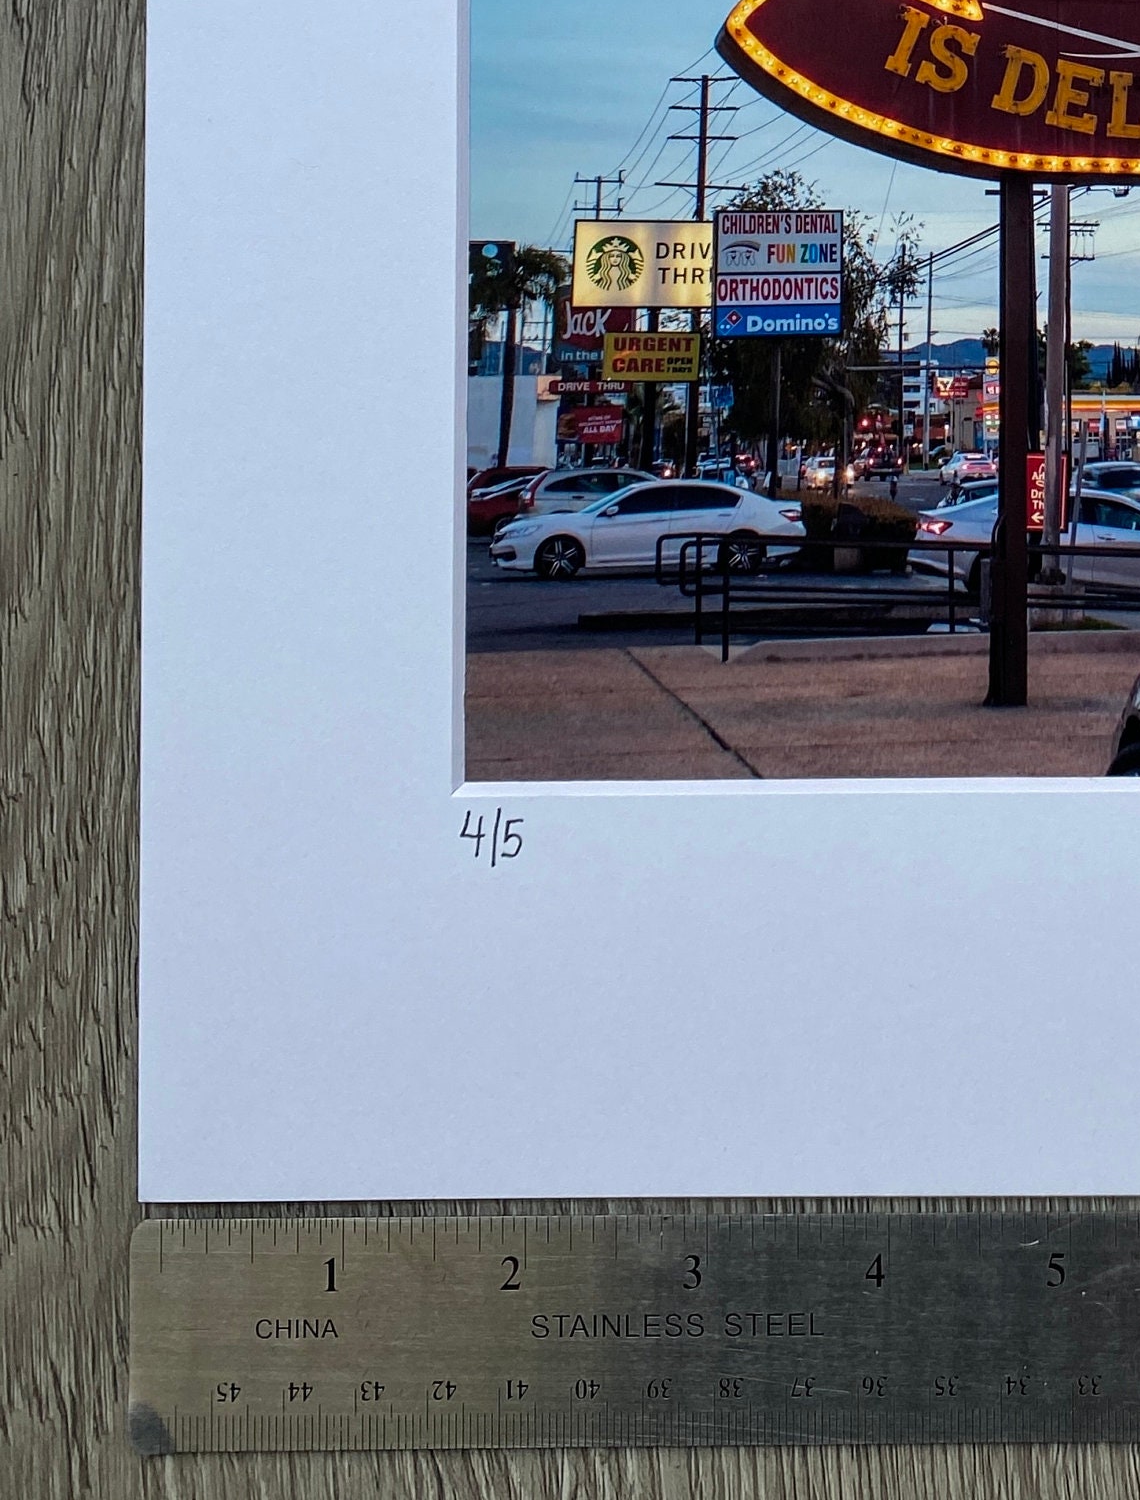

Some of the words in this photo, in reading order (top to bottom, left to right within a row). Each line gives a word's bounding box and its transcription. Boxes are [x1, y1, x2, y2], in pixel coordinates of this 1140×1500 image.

[884, 6, 981, 94] IS
[722, 214, 792, 235] CHILDREN'S
[795, 214, 838, 234] DENTAL
[656, 242, 712, 259] DRIV
[767, 243, 796, 264] FUN
[800, 243, 838, 263] ZONE
[658, 267, 714, 284] THR
[717, 276, 839, 302] ORTHODONTICS
[562, 300, 613, 340] Jack
[746, 313, 838, 333] Domino's
[613, 337, 694, 352] URGENT
[560, 350, 573, 361] in
[576, 350, 598, 361] the
[612, 357, 665, 373] CARE
[667, 357, 693, 365] OPEN
[557, 382, 590, 392] DRIVE
[597, 381, 625, 391] THRU
[583, 425, 598, 434] ALL
[599, 423, 617, 433] DAY
[1031, 489, 1045, 499] Dri
[1032, 500, 1045, 510] Th
[460, 807, 524, 868] 4/5
[323, 1257, 338, 1292] 1
[500, 1256, 521, 1291] 2
[682, 1255, 702, 1290] 3
[865, 1253, 885, 1288] 4
[1046, 1253, 1065, 1288] 5
[255, 1319, 339, 1339] CHINA
[531, 1314, 705, 1338] STAINLESS
[724, 1312, 825, 1337] STEEL
[217, 1382, 241, 1402] 45
[288, 1382, 313, 1402] 44
[360, 1381, 385, 1401] 43
[432, 1380, 457, 1401] 42
[505, 1380, 529, 1400] 41
[575, 1379, 601, 1399] 40
[647, 1378, 673, 1399] 39
[719, 1377, 744, 1398] 38
[790, 1376, 816, 1398] 37
[862, 1376, 888, 1396] 36
[934, 1376, 959, 1396] 35
[1006, 1376, 1031, 1396] 34
[1077, 1375, 1102, 1395] 33
